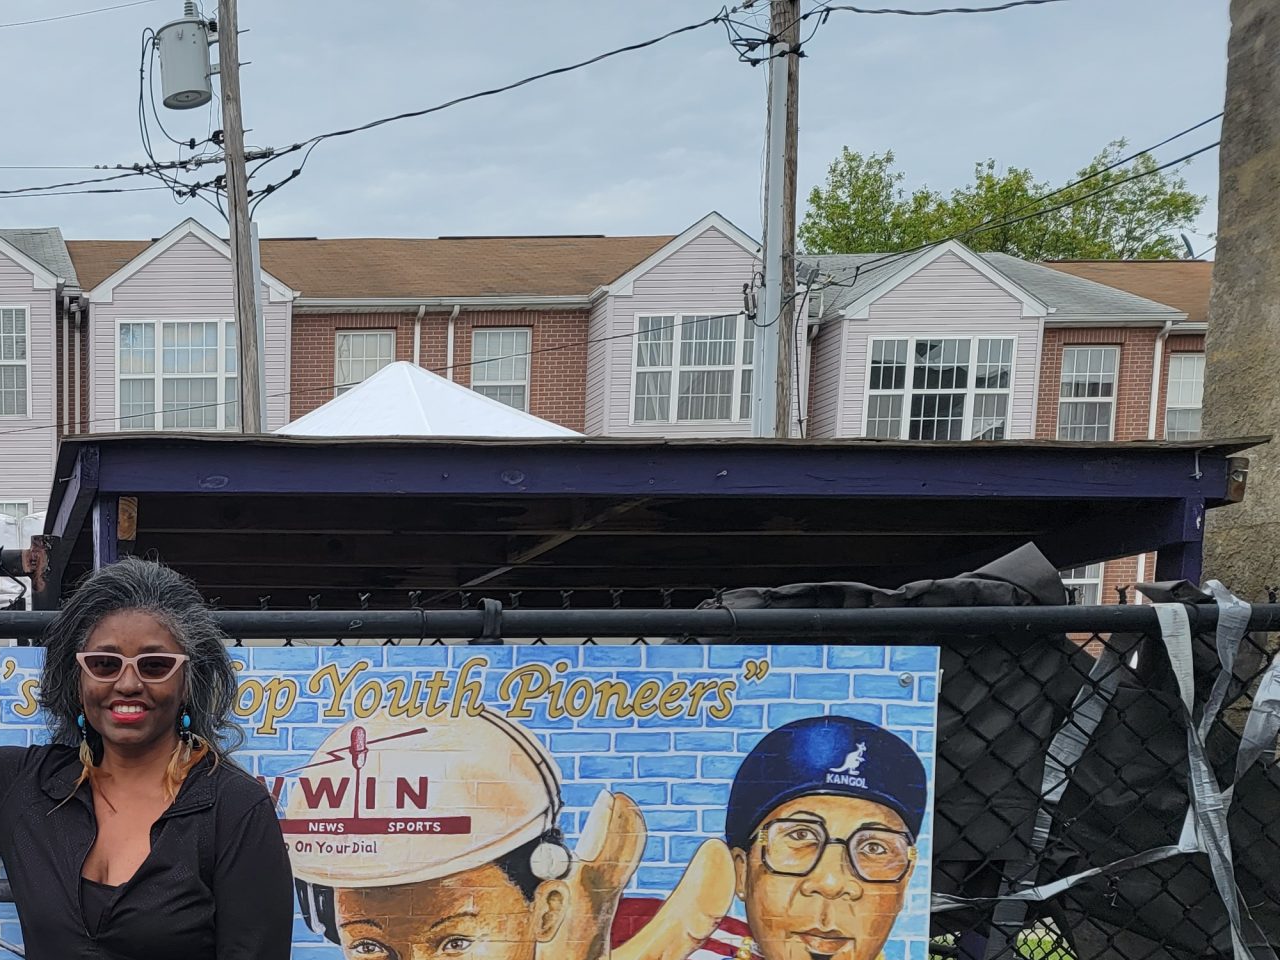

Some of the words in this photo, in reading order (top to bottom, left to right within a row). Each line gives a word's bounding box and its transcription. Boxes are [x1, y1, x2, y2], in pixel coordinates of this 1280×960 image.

[230, 661, 297, 734] op
[309, 657, 486, 718] Youth
[826, 773, 869, 789] KANGOL
[308, 822, 344, 832] NEWS
[387, 821, 441, 832] SPORTS
[295, 840, 312, 853] On
[351, 840, 377, 854] Dial
